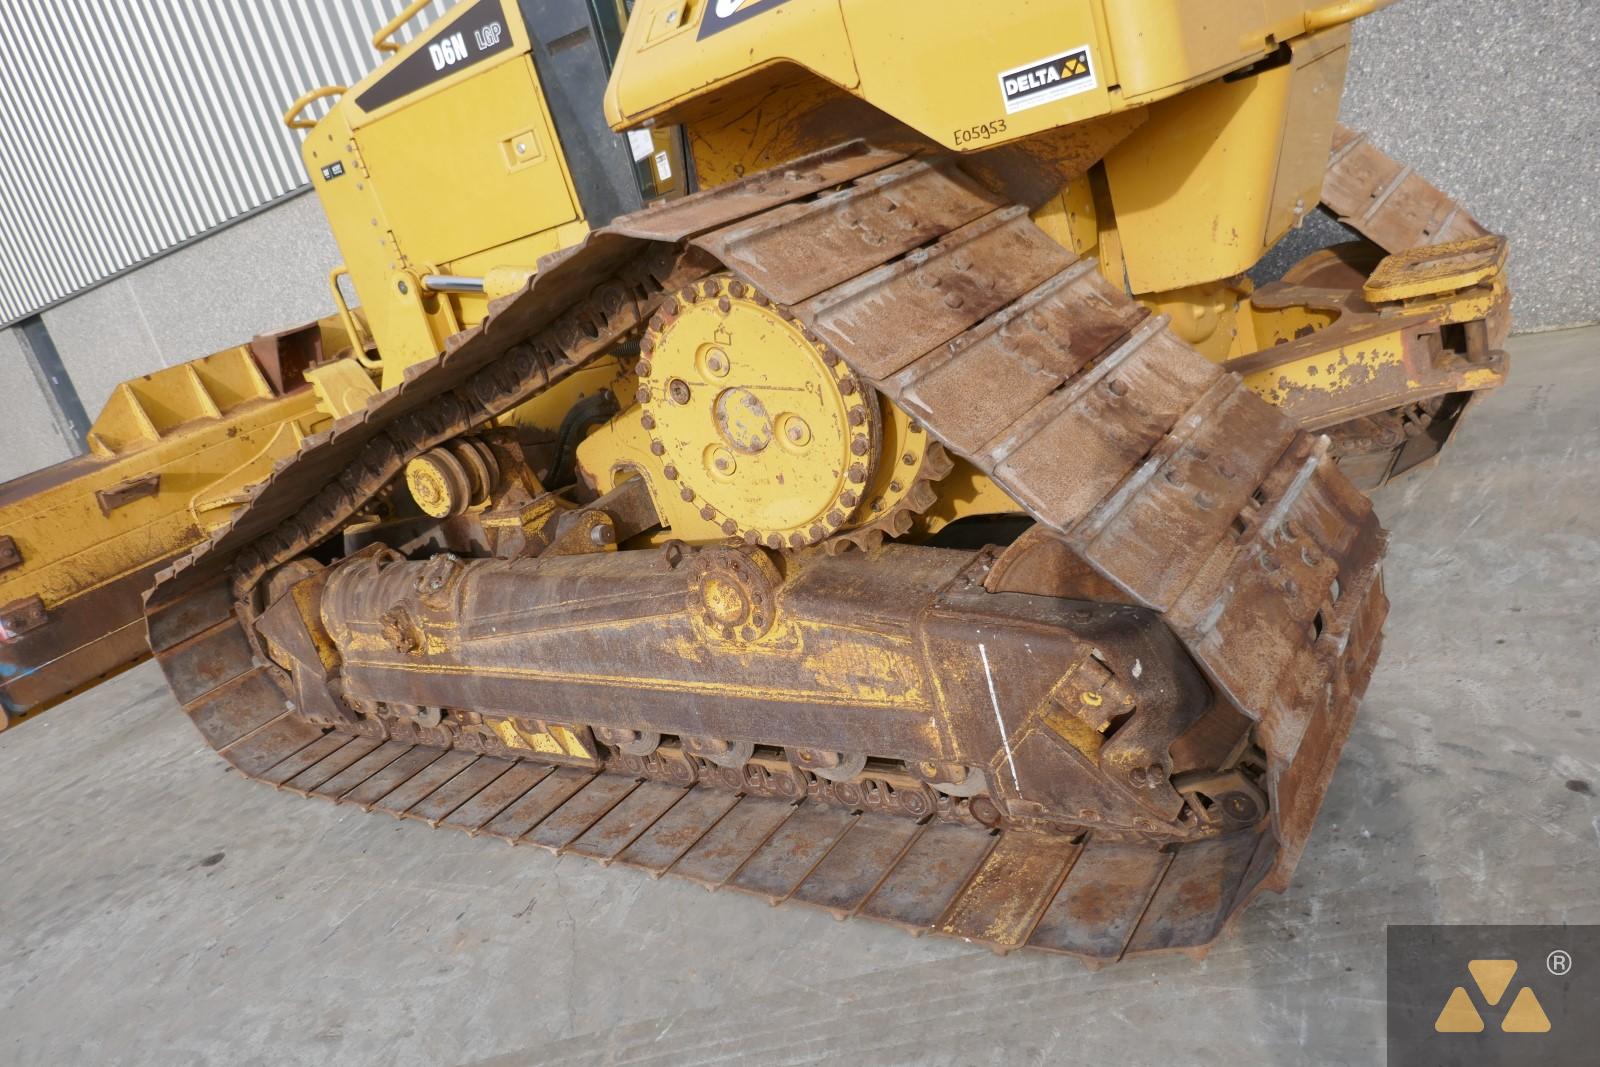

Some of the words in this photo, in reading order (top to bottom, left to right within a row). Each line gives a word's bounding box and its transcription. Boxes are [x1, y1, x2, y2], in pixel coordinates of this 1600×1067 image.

[428, 32, 468, 71] D6N
[474, 22, 502, 51] LGP
[1005, 65, 1060, 96] DELTA
[953, 119, 1007, 146] E05953
